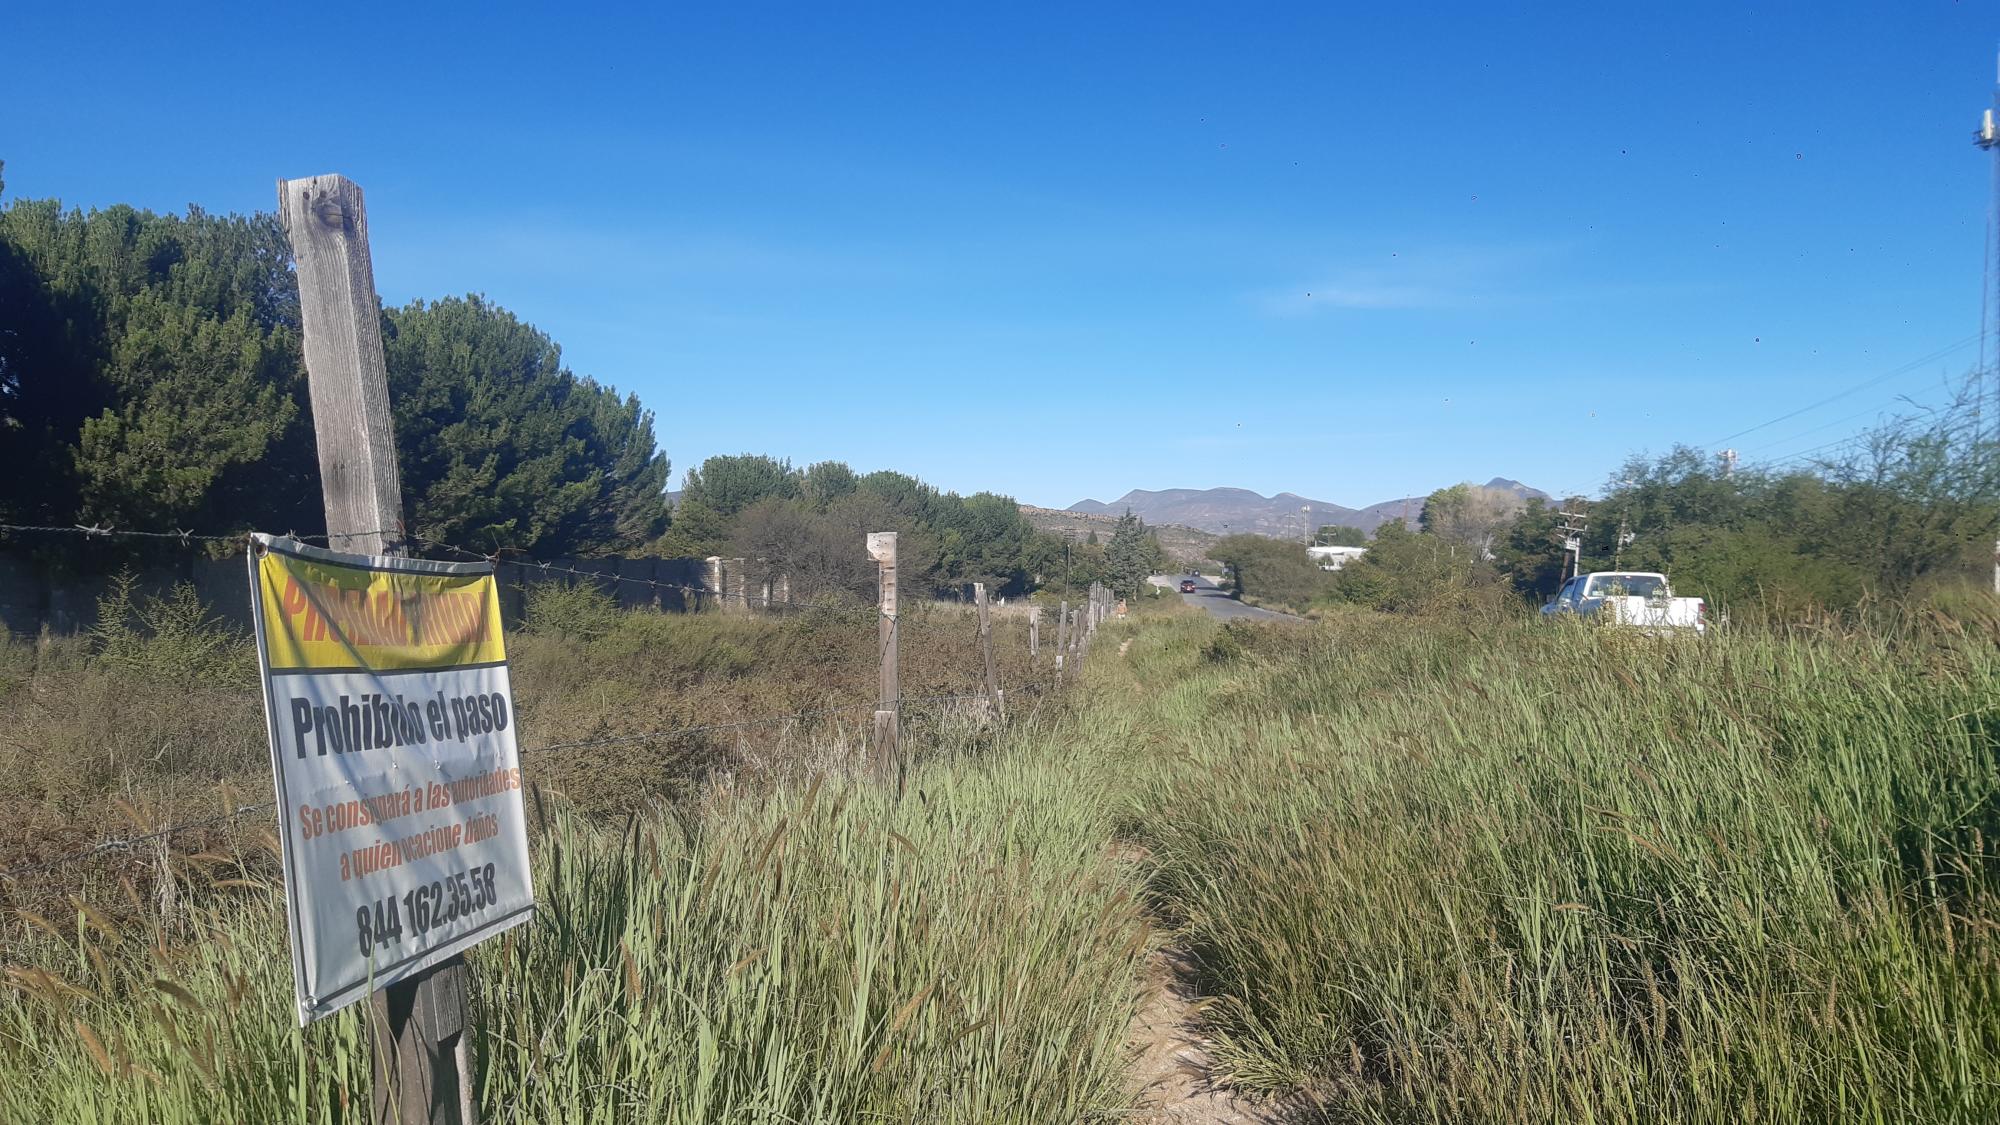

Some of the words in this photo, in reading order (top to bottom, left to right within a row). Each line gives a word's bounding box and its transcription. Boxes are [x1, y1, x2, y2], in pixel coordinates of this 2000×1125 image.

[291, 694, 427, 759] Prohibido
[426, 691, 452, 742] el
[451, 692, 508, 743] paso
[300, 803, 322, 840] Se
[414, 787, 423, 813] a
[426, 781, 451, 810] las
[340, 852, 351, 881] a
[352, 839, 403, 880] quien
[464, 812, 499, 845] daños
[356, 895, 403, 958] 844
[403, 862, 497, 938] 162.35.58
